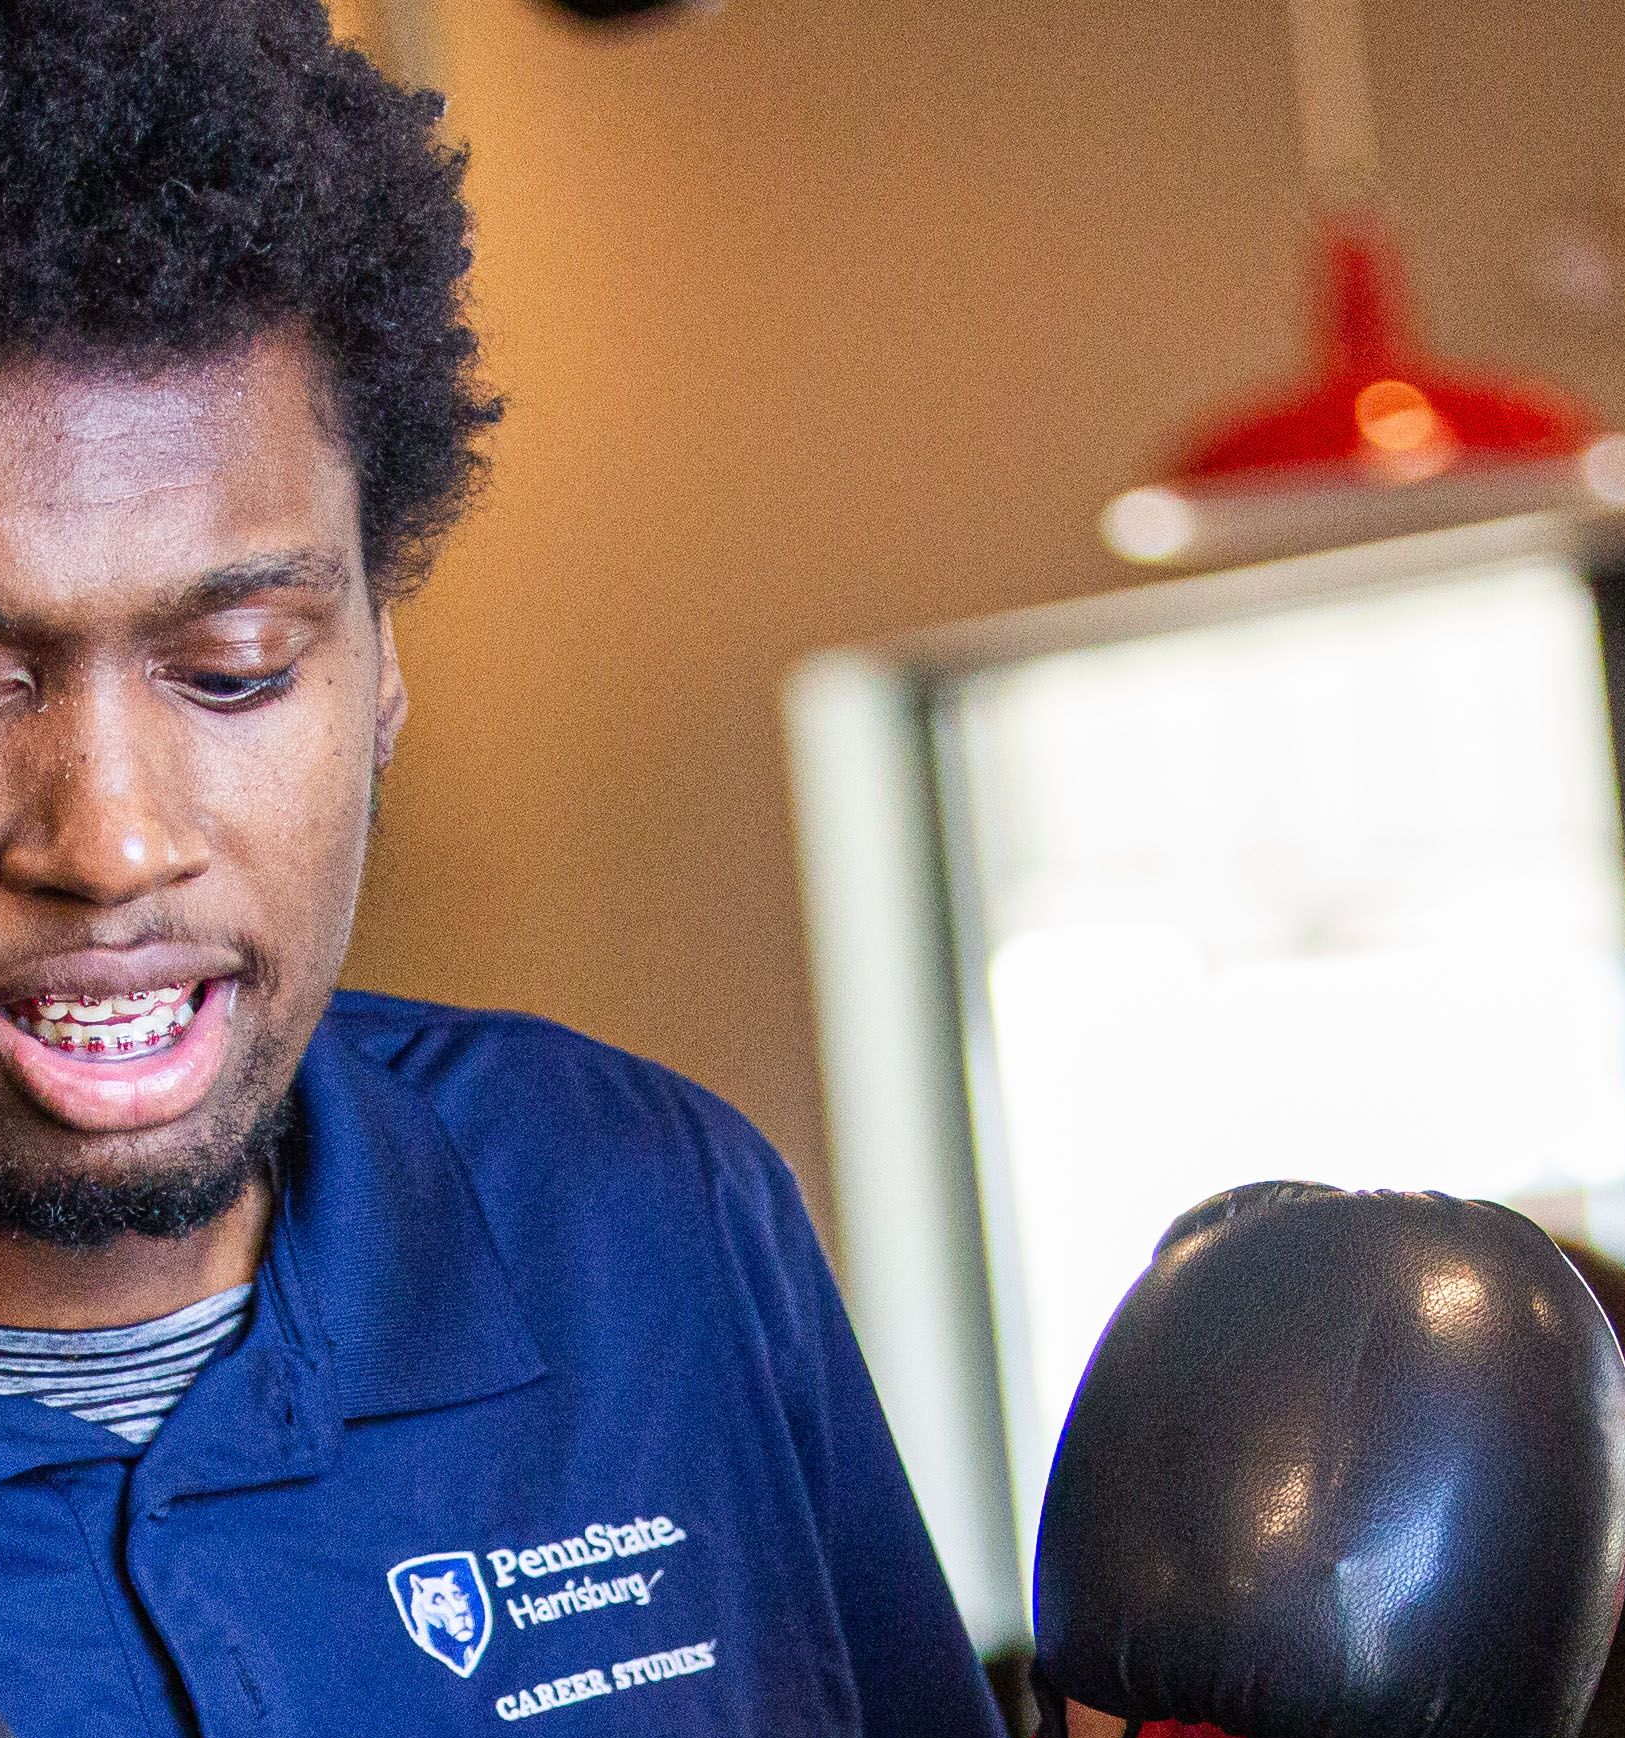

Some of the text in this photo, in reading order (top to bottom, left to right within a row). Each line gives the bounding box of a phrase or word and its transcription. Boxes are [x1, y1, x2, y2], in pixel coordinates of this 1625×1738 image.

[507, 1572, 655, 1630] Harrisburg
[495, 1642, 717, 1721] CAREER STUDIES
